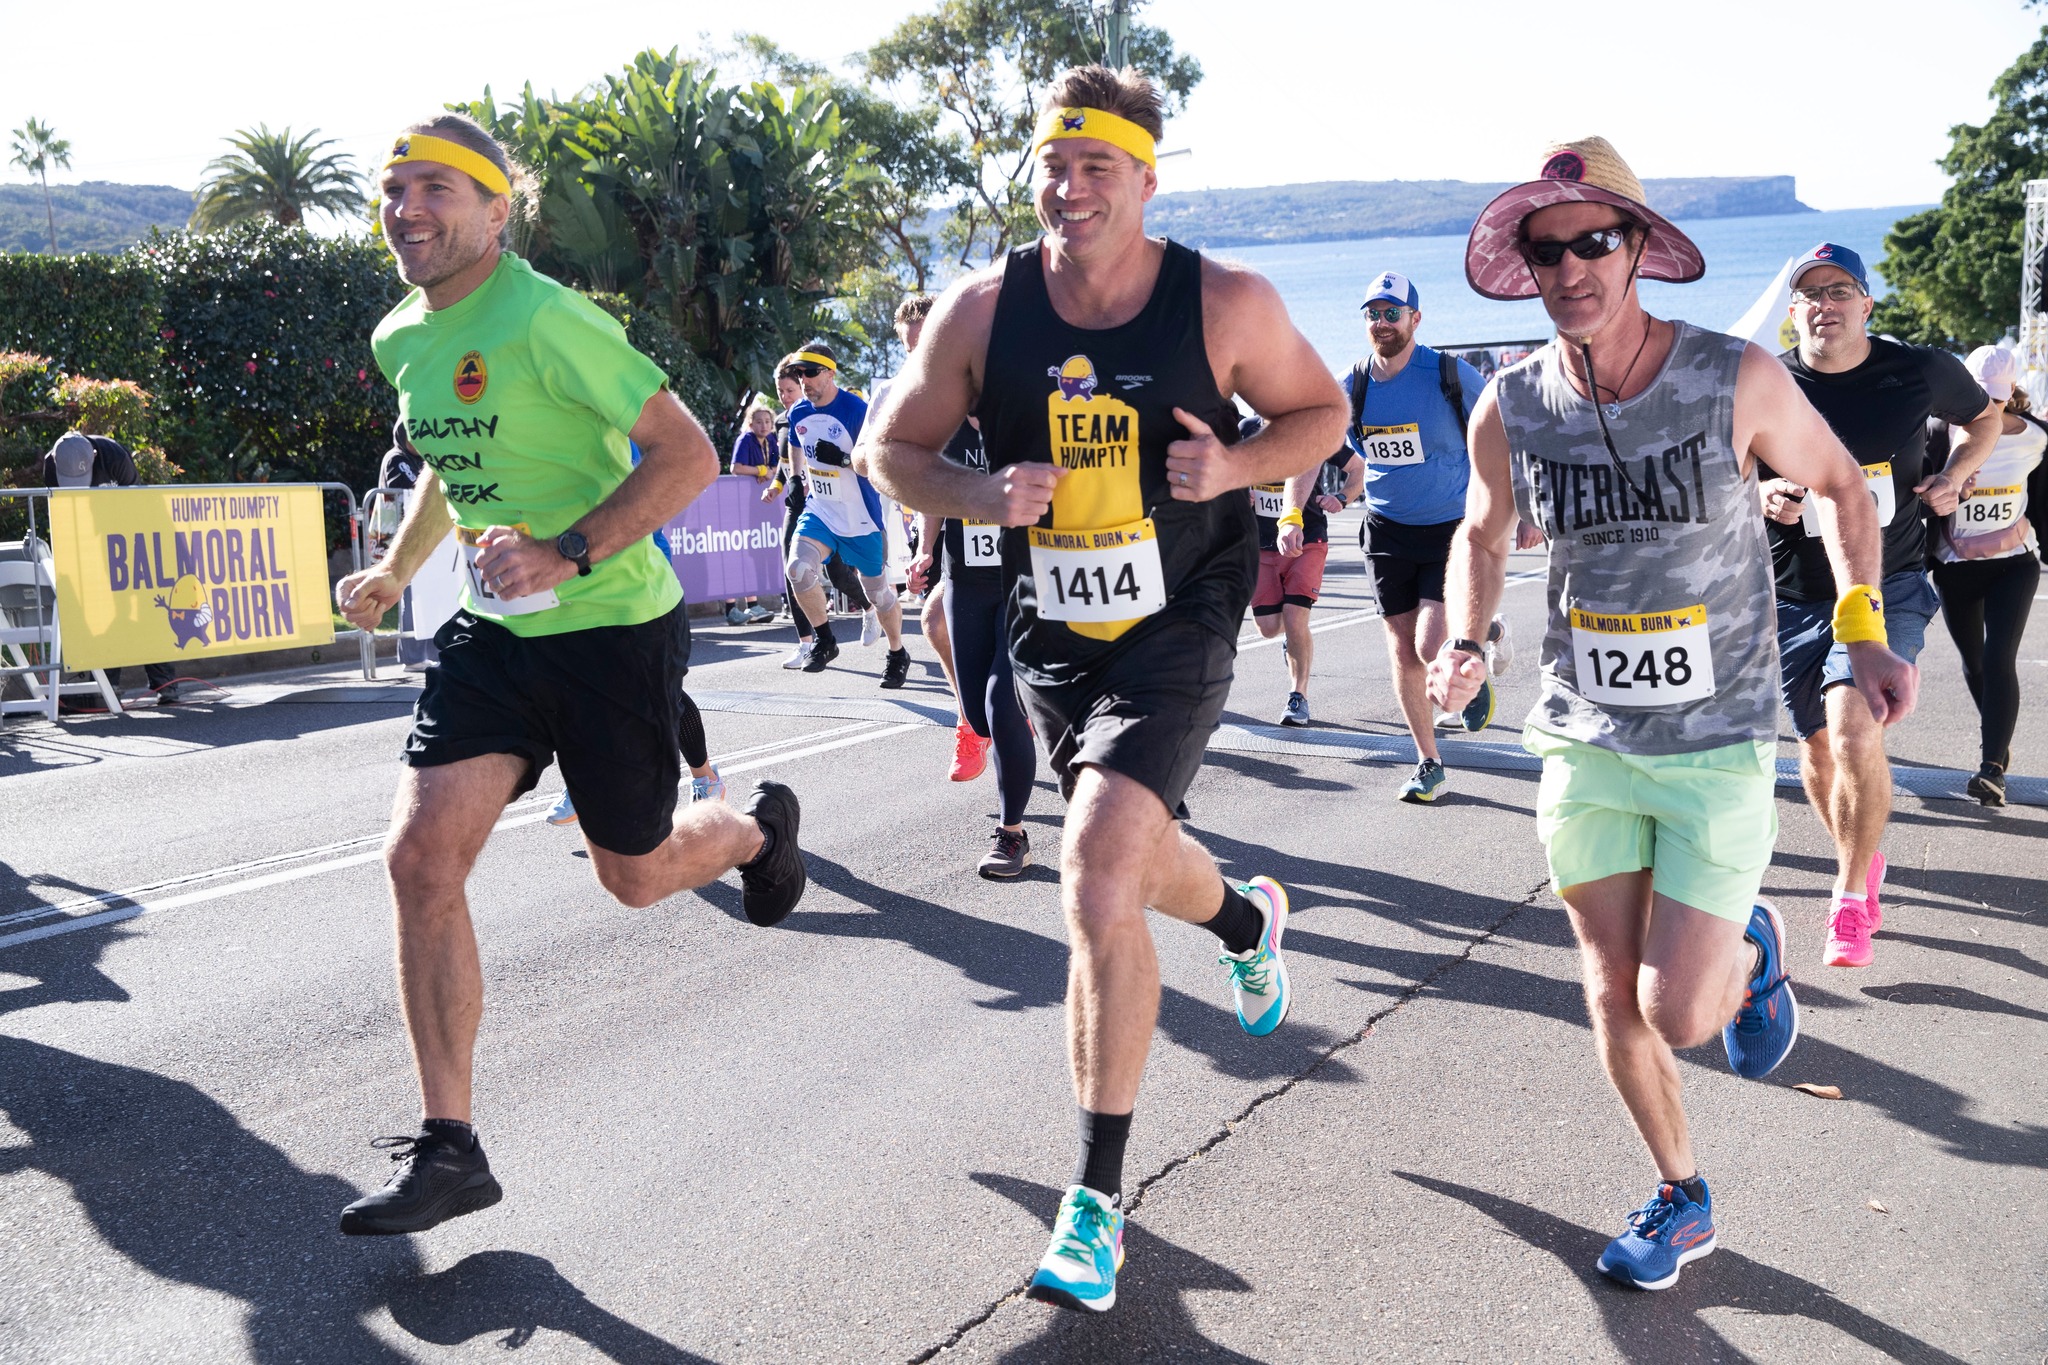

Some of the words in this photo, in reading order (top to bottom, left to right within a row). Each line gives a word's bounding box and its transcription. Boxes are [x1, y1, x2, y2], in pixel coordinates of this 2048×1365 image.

[1057, 414, 1129, 444] TEAM
[1060, 445, 1128, 469] HUMPTY
[1369, 440, 1415, 459] 1838
[812, 479, 832, 495] 1311
[1530, 430, 1709, 534] EVERLAST
[171, 496, 227, 522] HUMPTY
[229, 495, 280, 520] DUMPTY
[1963, 502, 2012, 522] 1845
[971, 534, 1002, 557] 13
[1036, 531, 1090, 549] BALMORAL
[1093, 530, 1124, 548] BURN
[1582, 529, 1625, 546] SINCE
[1631, 527, 1660, 543] 1910
[106, 527, 287, 592] BALMORAL
[1050, 562, 1141, 606] 1414
[211, 582, 295, 643] BURN
[1579, 613, 1637, 633] BALMORAL
[1641, 615, 1673, 631] BURN
[1587, 646, 1692, 689] 1248
